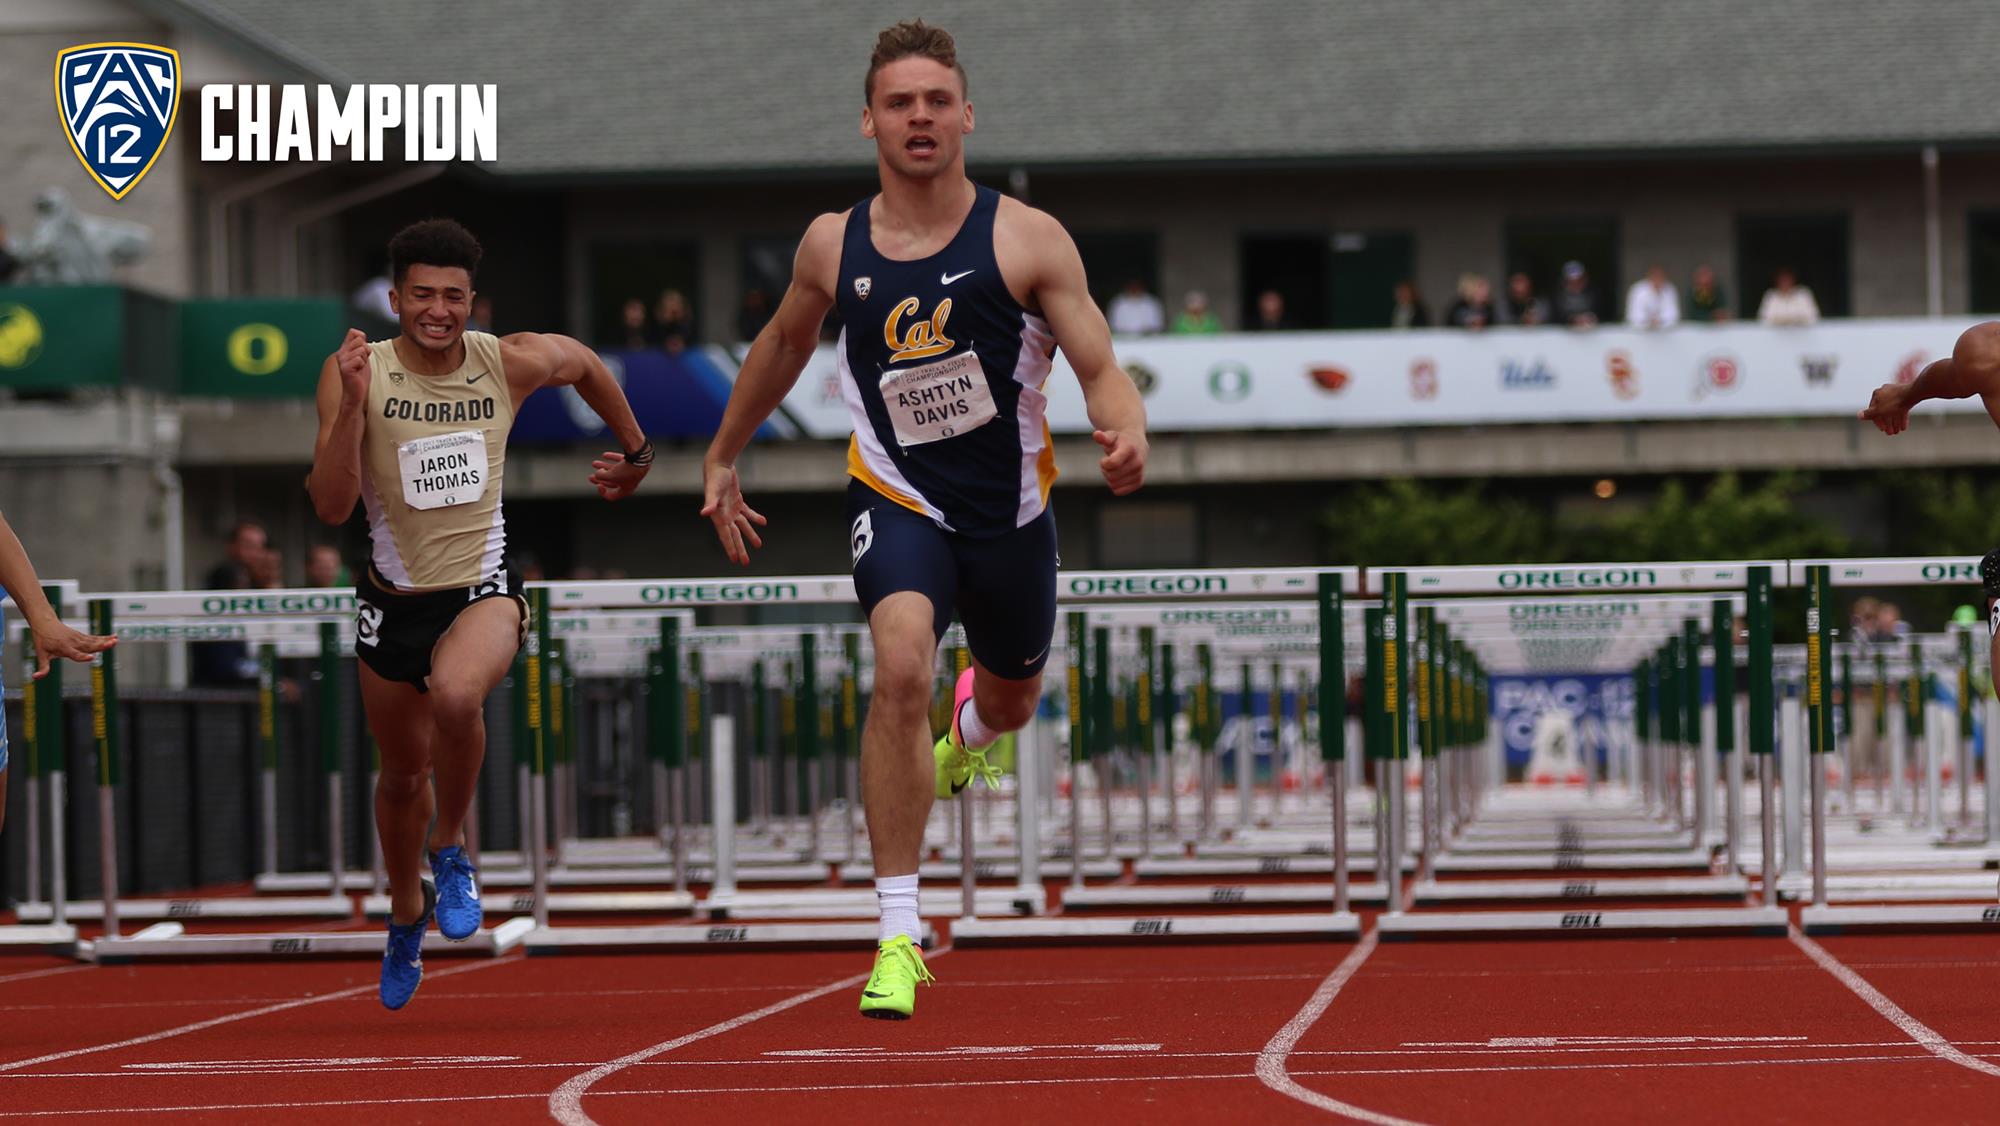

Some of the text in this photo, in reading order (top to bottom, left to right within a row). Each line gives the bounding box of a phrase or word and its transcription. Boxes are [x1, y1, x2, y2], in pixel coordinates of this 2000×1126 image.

[884, 297, 955, 356] Cal
[906, 362, 967, 384] CHAMPIONSHIPS
[898, 375, 972, 407] ASHTYN
[384, 397, 494, 423] COLORADO
[913, 399, 969, 425] DAVIS
[420, 453, 468, 474] JARON
[413, 470, 479, 493] THOMAS
[1071, 576, 1227, 595] OREGON
[1498, 569, 1656, 589] OREGON
[641, 583, 797, 603] OREGON
[203, 594, 356, 614] OREGON
[1132, 919, 1174, 934] GILL
[1561, 914, 1602, 928] GILL
[706, 926, 748, 941] GILL
